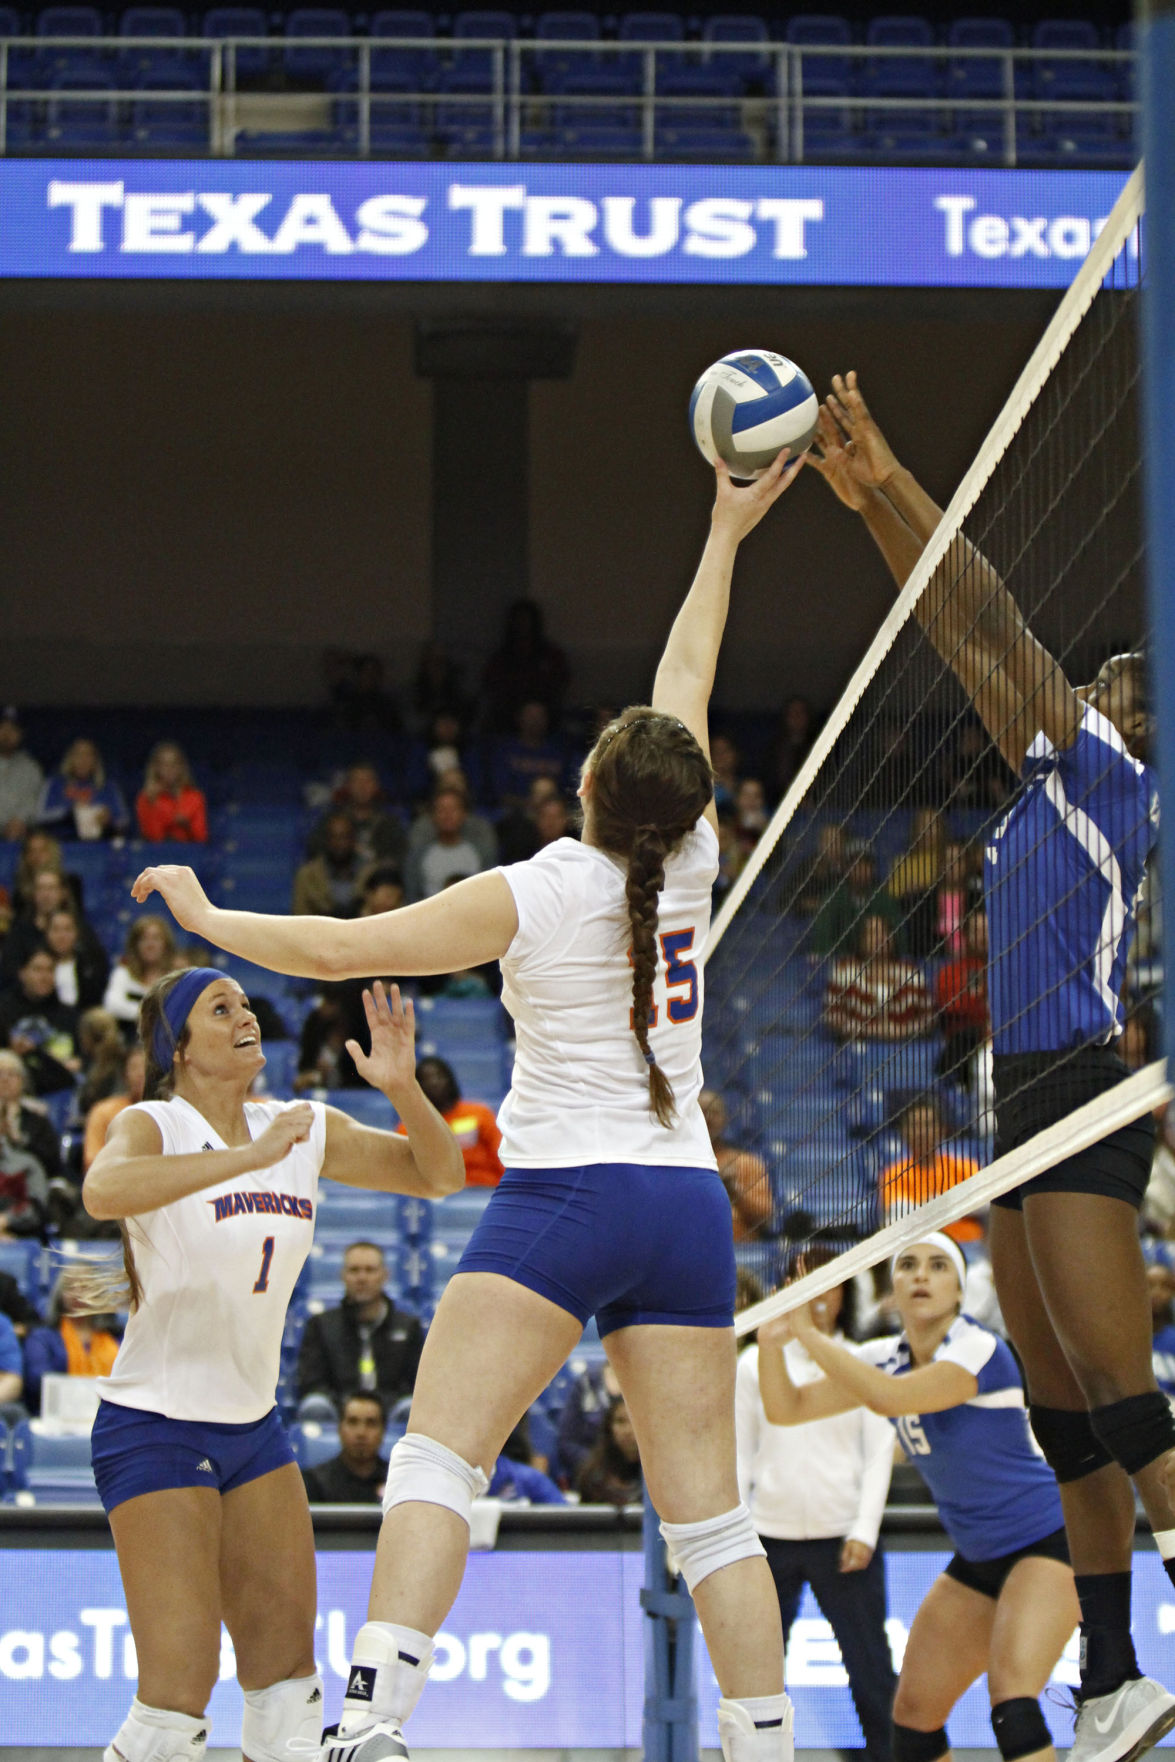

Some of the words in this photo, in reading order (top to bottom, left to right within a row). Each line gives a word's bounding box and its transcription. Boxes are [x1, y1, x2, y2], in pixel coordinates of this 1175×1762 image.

[48, 180, 430, 255] TEXAS
[448, 184, 824, 259] TRUST
[206, 1191, 313, 1223] MAVERICKS
[252, 1235, 275, 1294] 1
